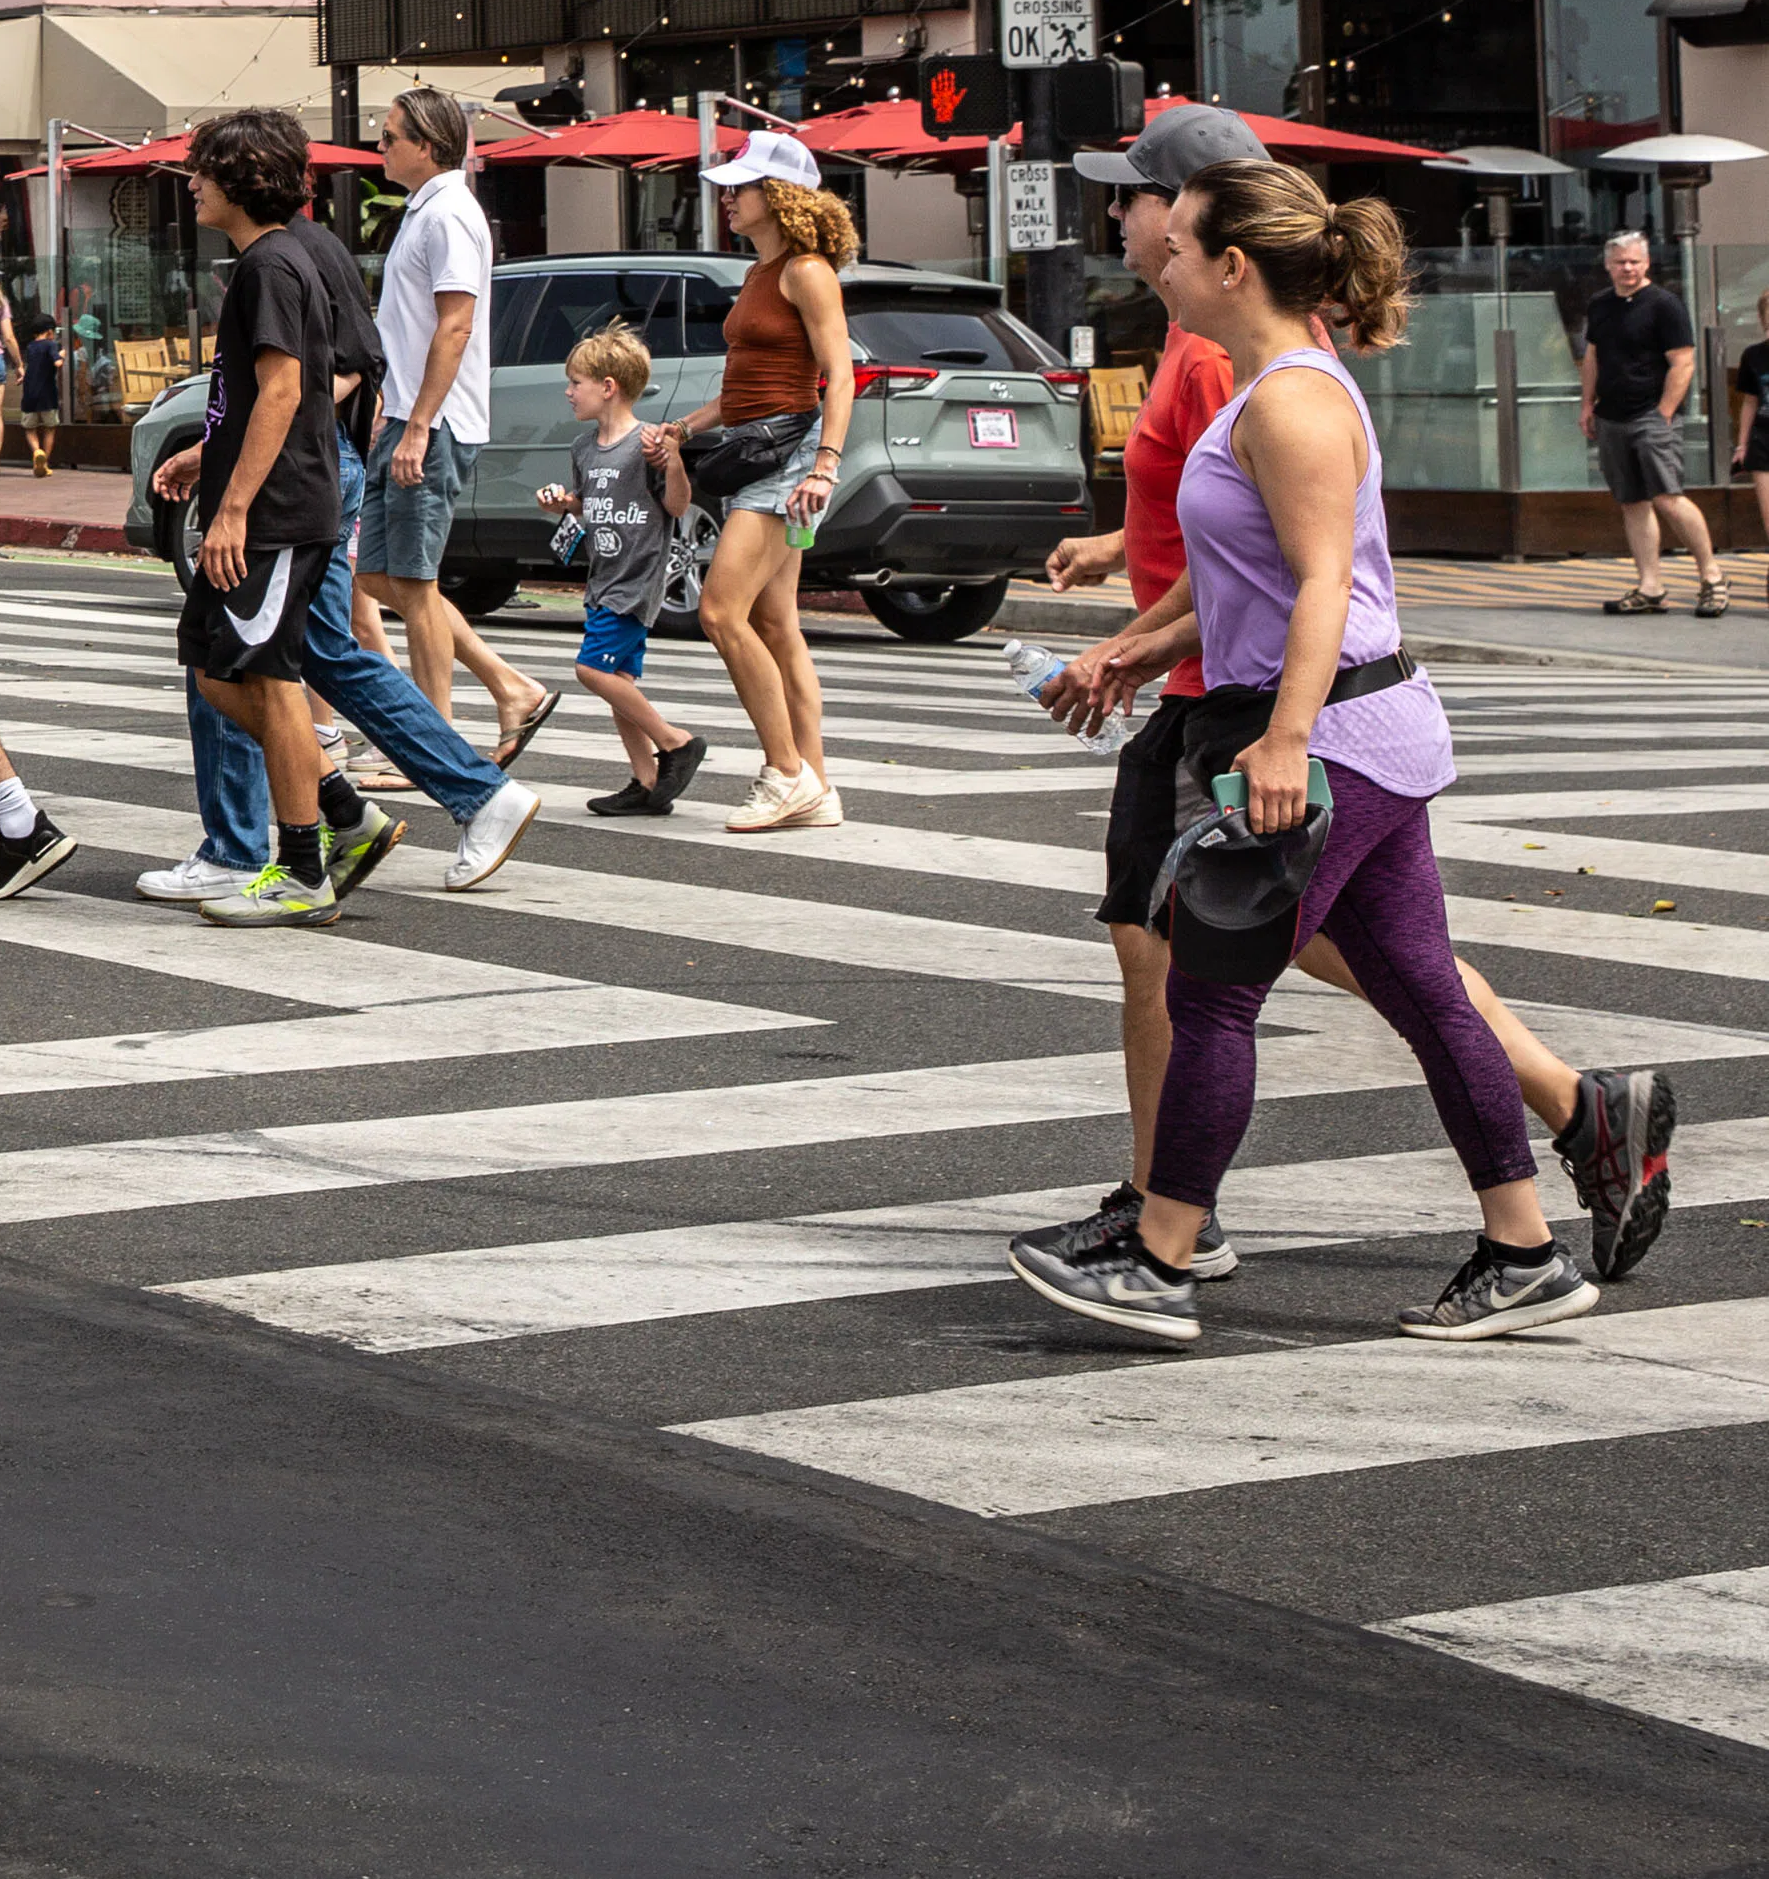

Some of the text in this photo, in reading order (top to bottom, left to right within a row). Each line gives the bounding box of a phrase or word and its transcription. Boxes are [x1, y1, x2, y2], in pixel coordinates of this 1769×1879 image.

[1013, 0, 1084, 15] CROSSING
[1008, 26, 1040, 58] OK
[1010, 167, 1049, 182] CROSS
[1023, 183, 1037, 195] ON
[1015, 198, 1046, 211] WALK
[1011, 213, 1052, 228] SIGNAL
[1017, 229, 1046, 244] ONLY
